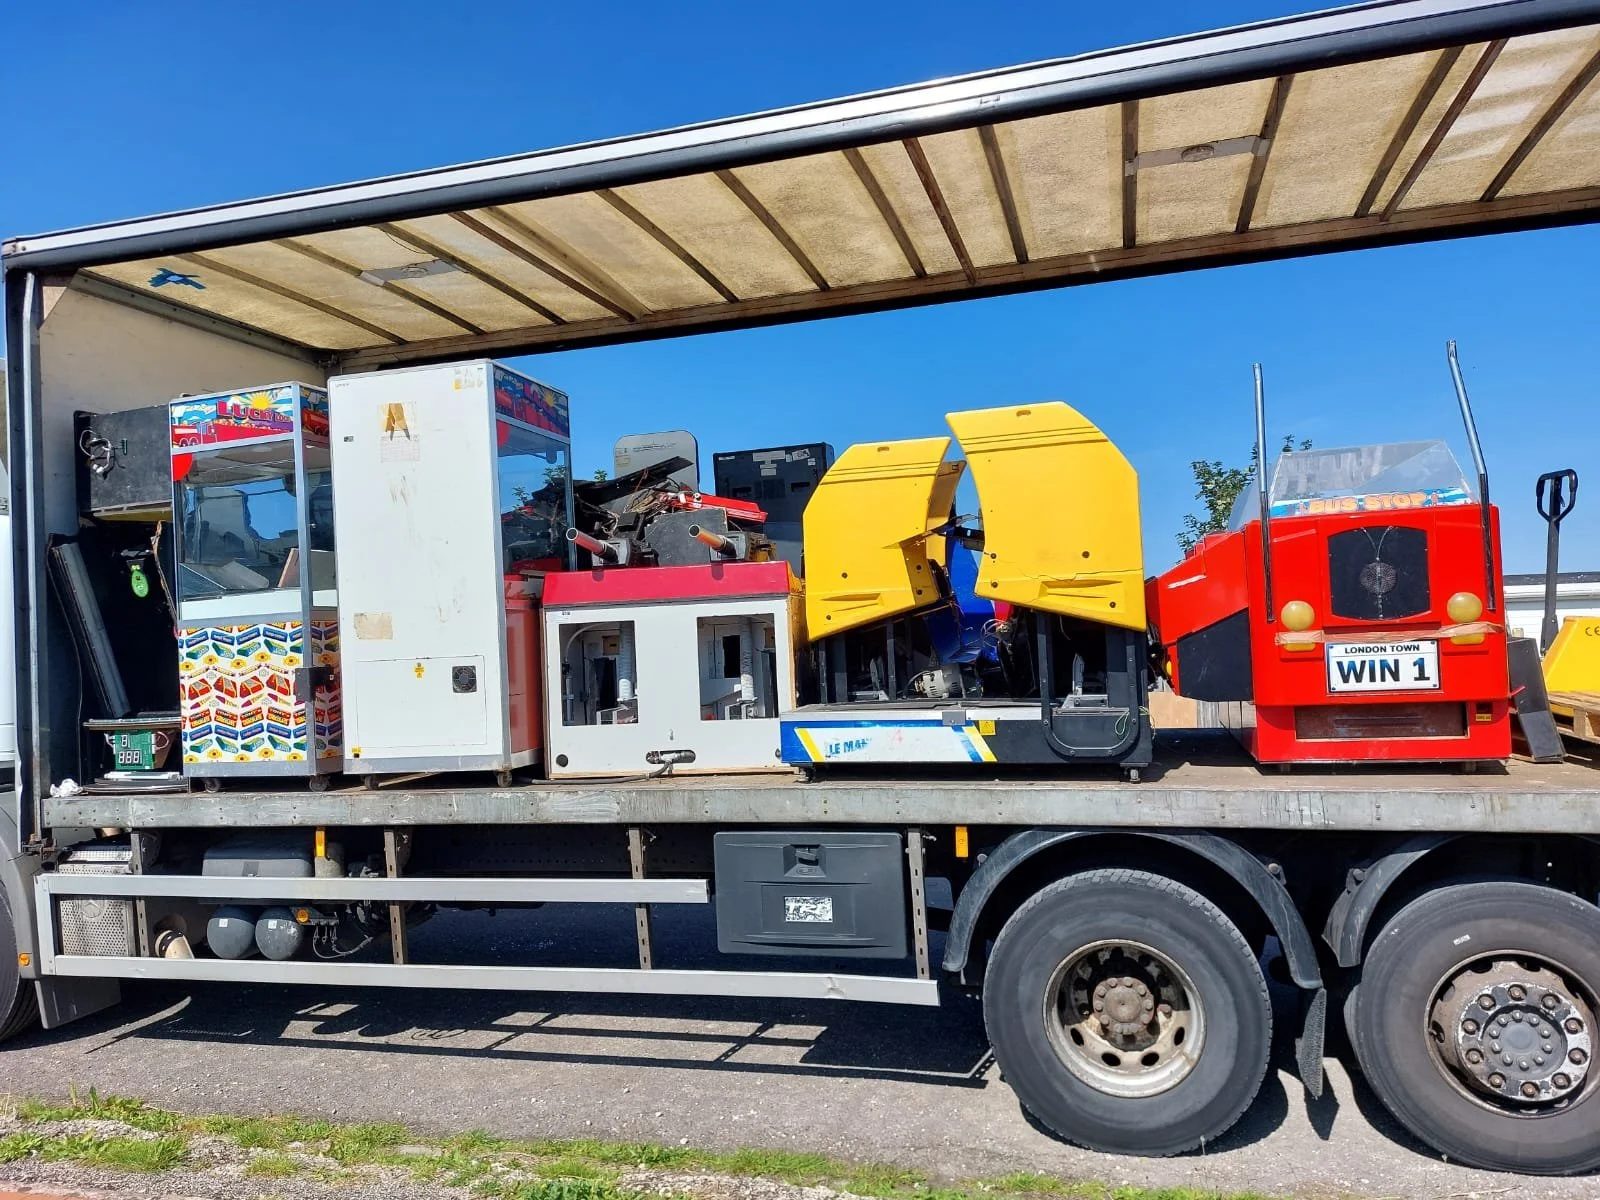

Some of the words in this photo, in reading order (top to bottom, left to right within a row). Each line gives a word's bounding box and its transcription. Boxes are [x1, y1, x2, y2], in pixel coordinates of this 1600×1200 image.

[1309, 497, 1358, 514] BUS
[1364, 492, 1427, 511] STOP
[1344, 645, 1387, 654] LONDON
[1390, 644, 1420, 653] TOWN
[1336, 658, 1400, 684] WIN
[1412, 657, 1431, 682] 1
